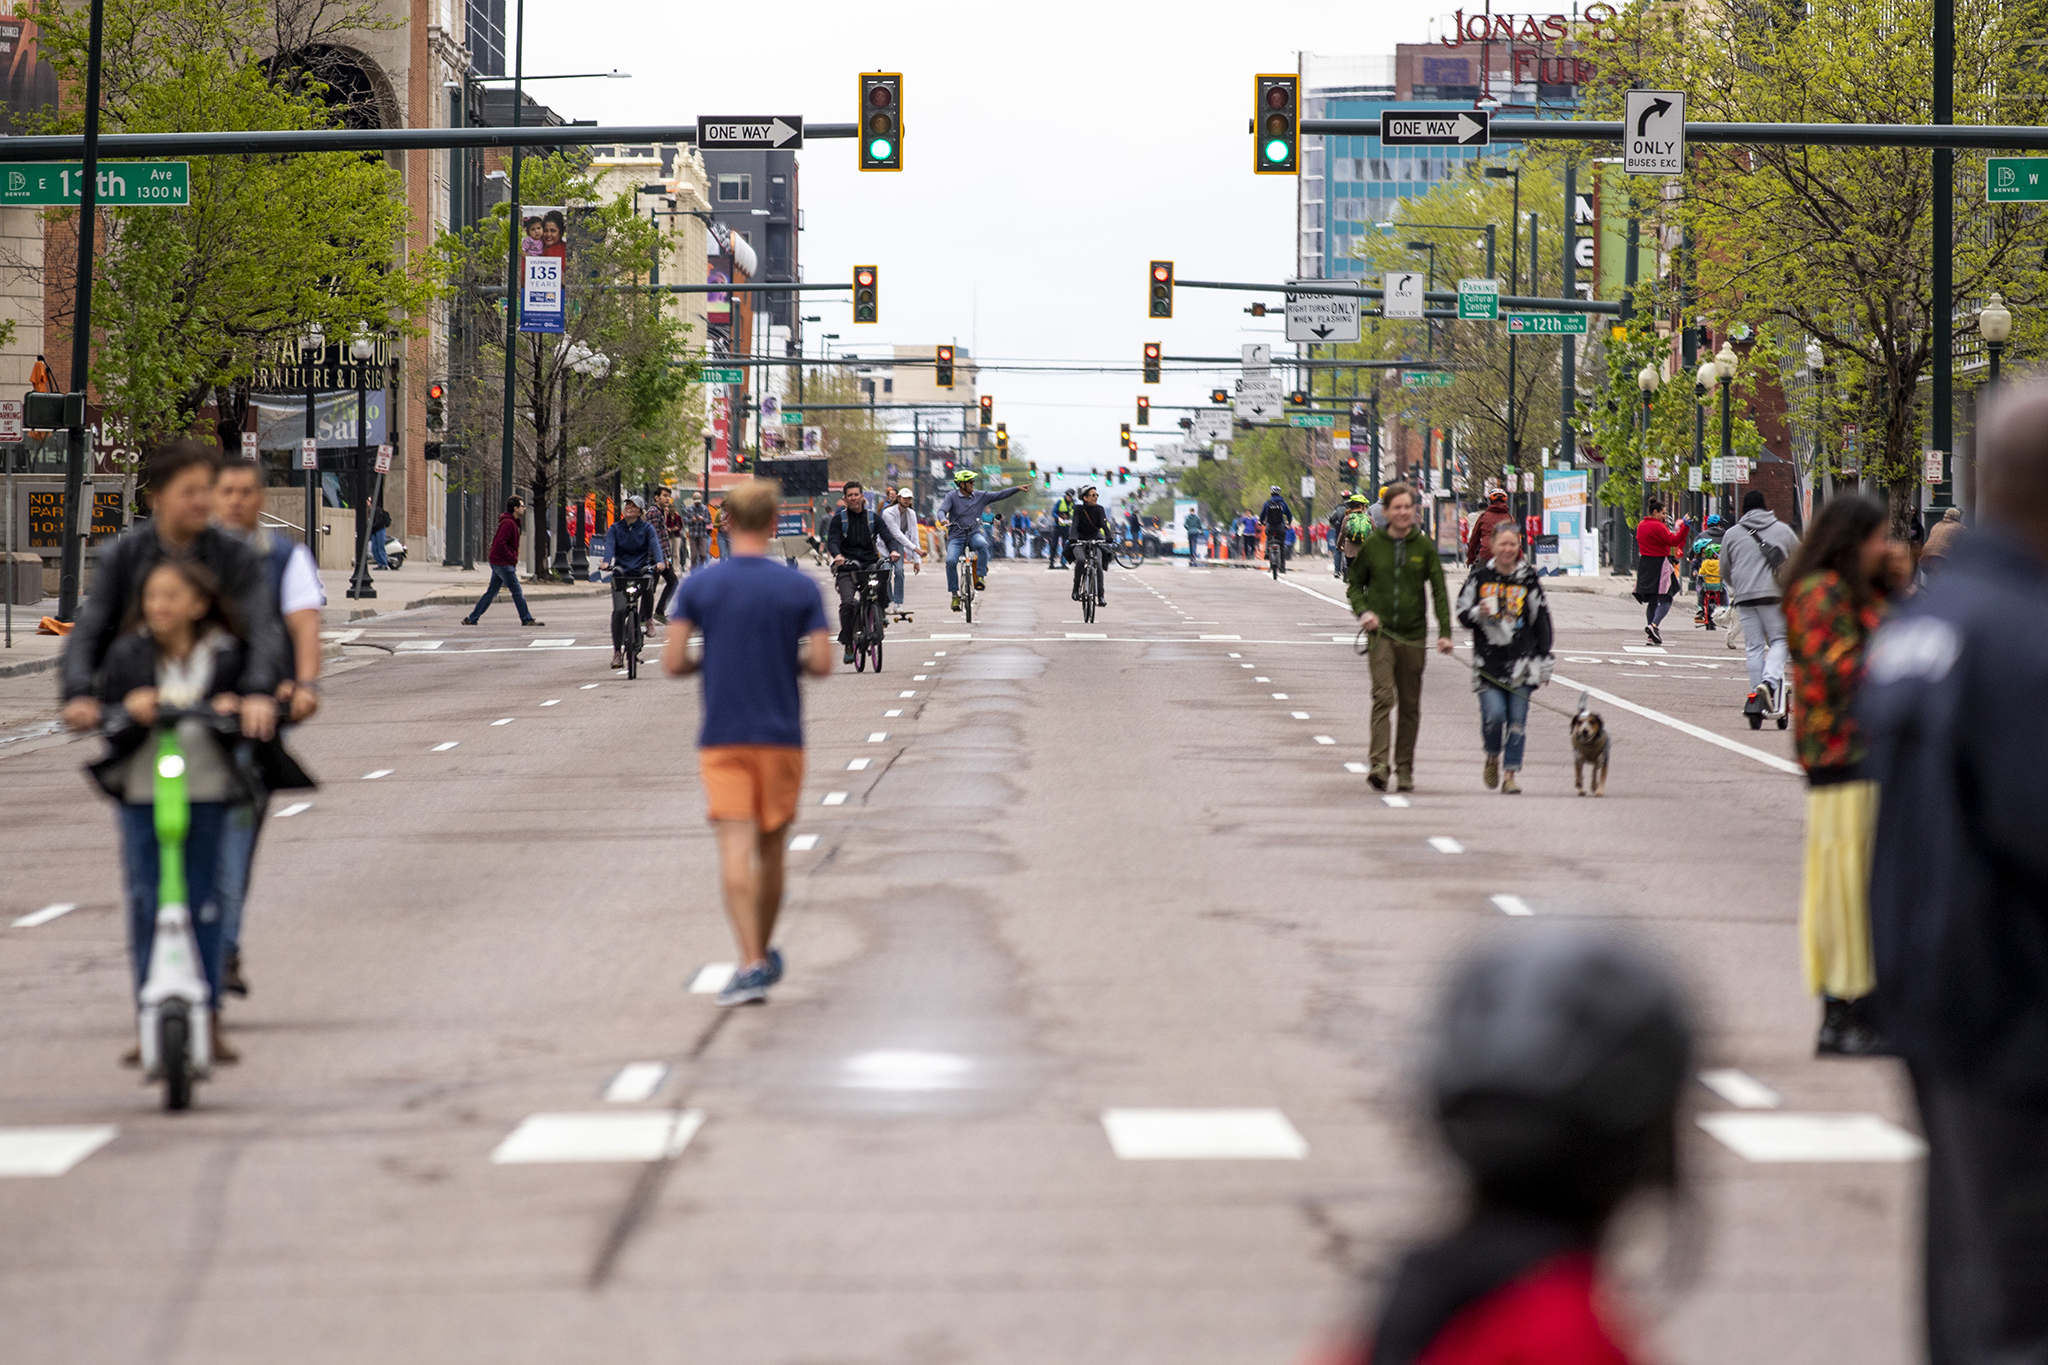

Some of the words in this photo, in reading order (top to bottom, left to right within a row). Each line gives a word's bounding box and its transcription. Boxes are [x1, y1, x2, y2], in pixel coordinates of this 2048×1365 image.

[1441, 8, 1568, 49] JONAS
[709, 126, 737, 139] ONE
[742, 126, 771, 139] WAY
[1393, 121, 1421, 135] ONE
[1426, 121, 1455, 135] WAY
[1633, 141, 1675, 155] ONLY
[1628, 158, 1657, 168] BUSES
[1660, 158, 1679, 168] EXC.
[150, 169, 172, 180] Ave
[2028, 173, 2039, 185] W
[39, 178, 47, 190] E
[137, 187, 169, 198] 1300
[173, 187, 182, 197] N
[530, 266, 557, 280] 135
[1462, 282, 1495, 293] PARKING
[1395, 290, 1413, 298] ONLY
[1463, 294, 1494, 303] Cultural
[1288, 304, 1308, 313] RIGHT
[1308, 304, 1330, 313] TURNS
[1331, 302, 1357, 315] ONLY
[1465, 303, 1491, 311] Center
[1293, 316, 1313, 324] WHEN
[1532, 318, 1562, 331] 12th
[336, 368, 346, 389] &
[350, 368, 386, 389] DSIGN
[2, 403, 14, 412] NO
[30, 494, 54, 505] NO
[30, 506, 104, 517] PARG
